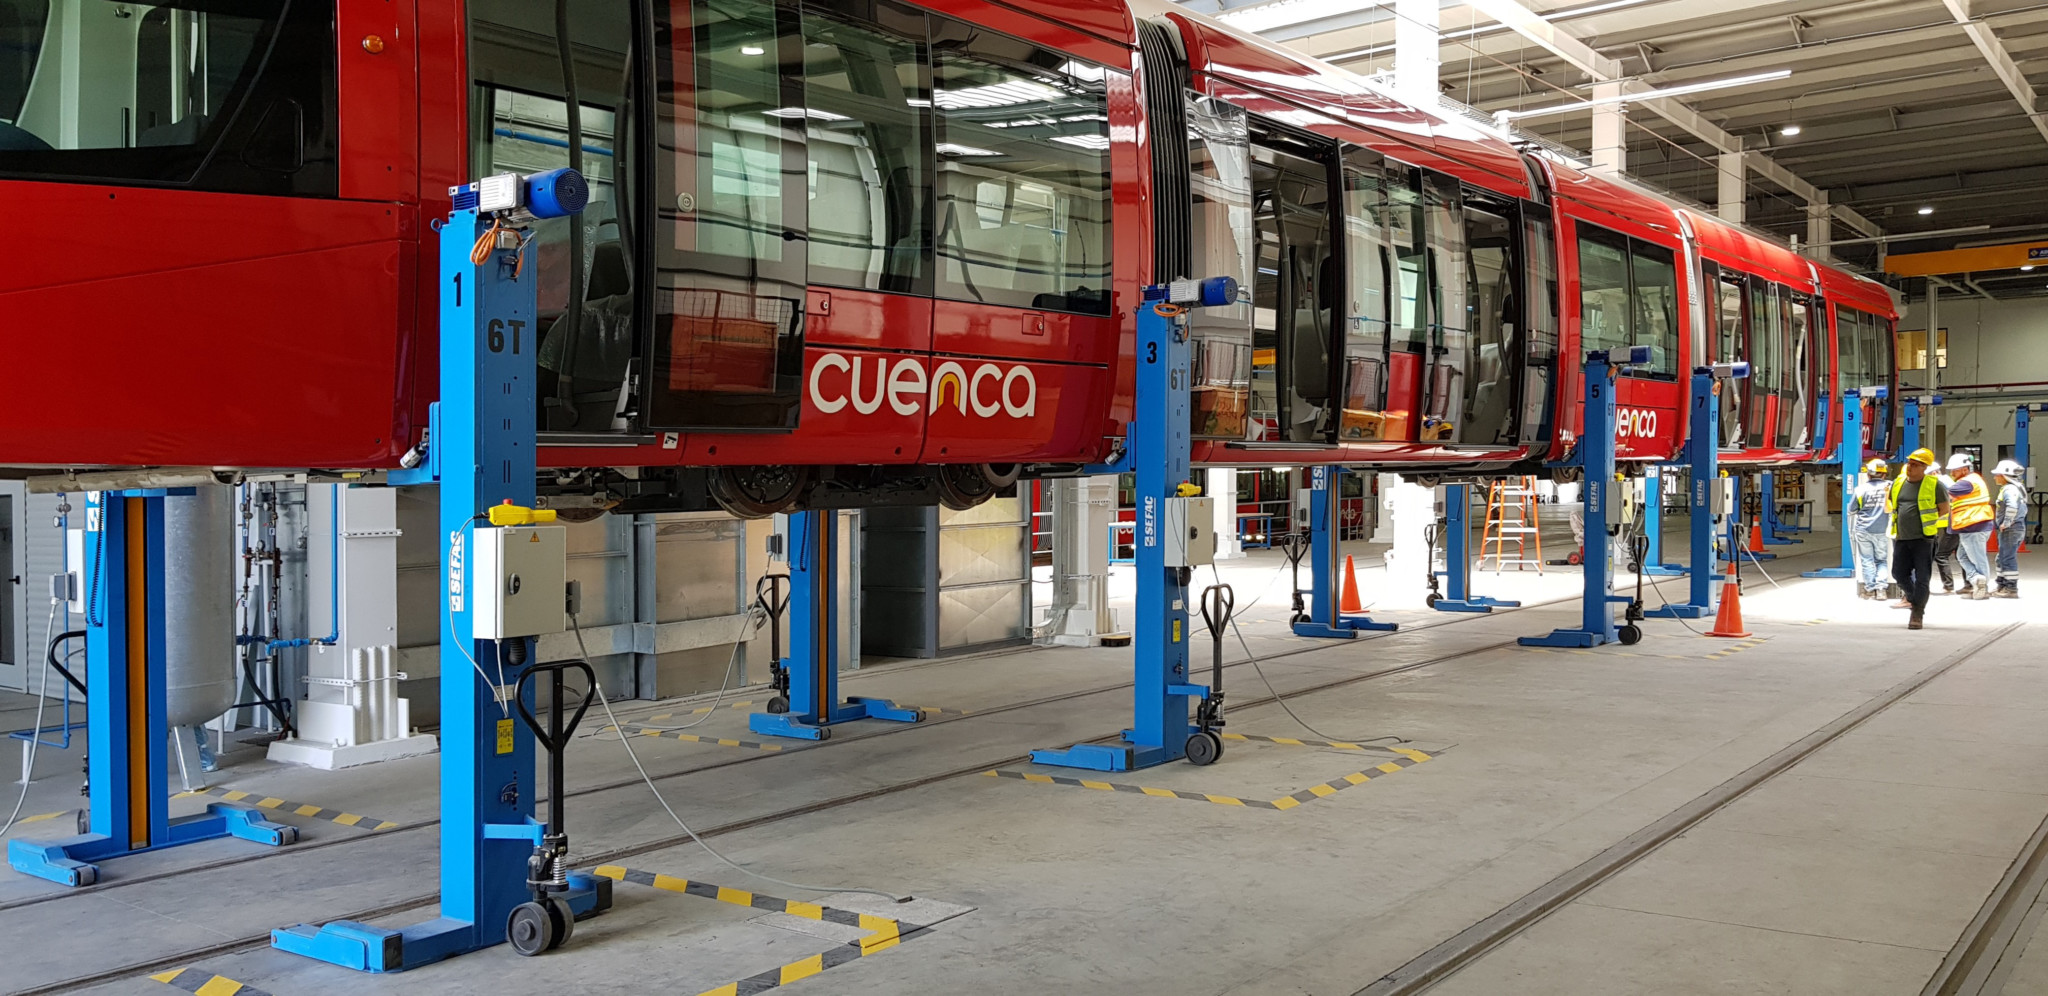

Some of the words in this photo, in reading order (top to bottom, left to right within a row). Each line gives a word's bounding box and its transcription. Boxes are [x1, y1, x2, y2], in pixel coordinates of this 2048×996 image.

[453, 272, 462, 307] 1
[488, 319, 525, 354] 6T
[1147, 341, 1157, 364] 3
[809, 353, 1036, 418] cuenca
[1170, 368, 1186, 391] 6T
[1591, 384, 1600, 398] 5
[1697, 396, 1705, 408] 7
[1848, 412, 1854, 420] 9
[1907, 417, 1914, 425] 11
[1590, 480, 1598, 506] SEFAC
[1144, 496, 1154, 535] SEFAC
[450, 531, 462, 595] SEFAC
